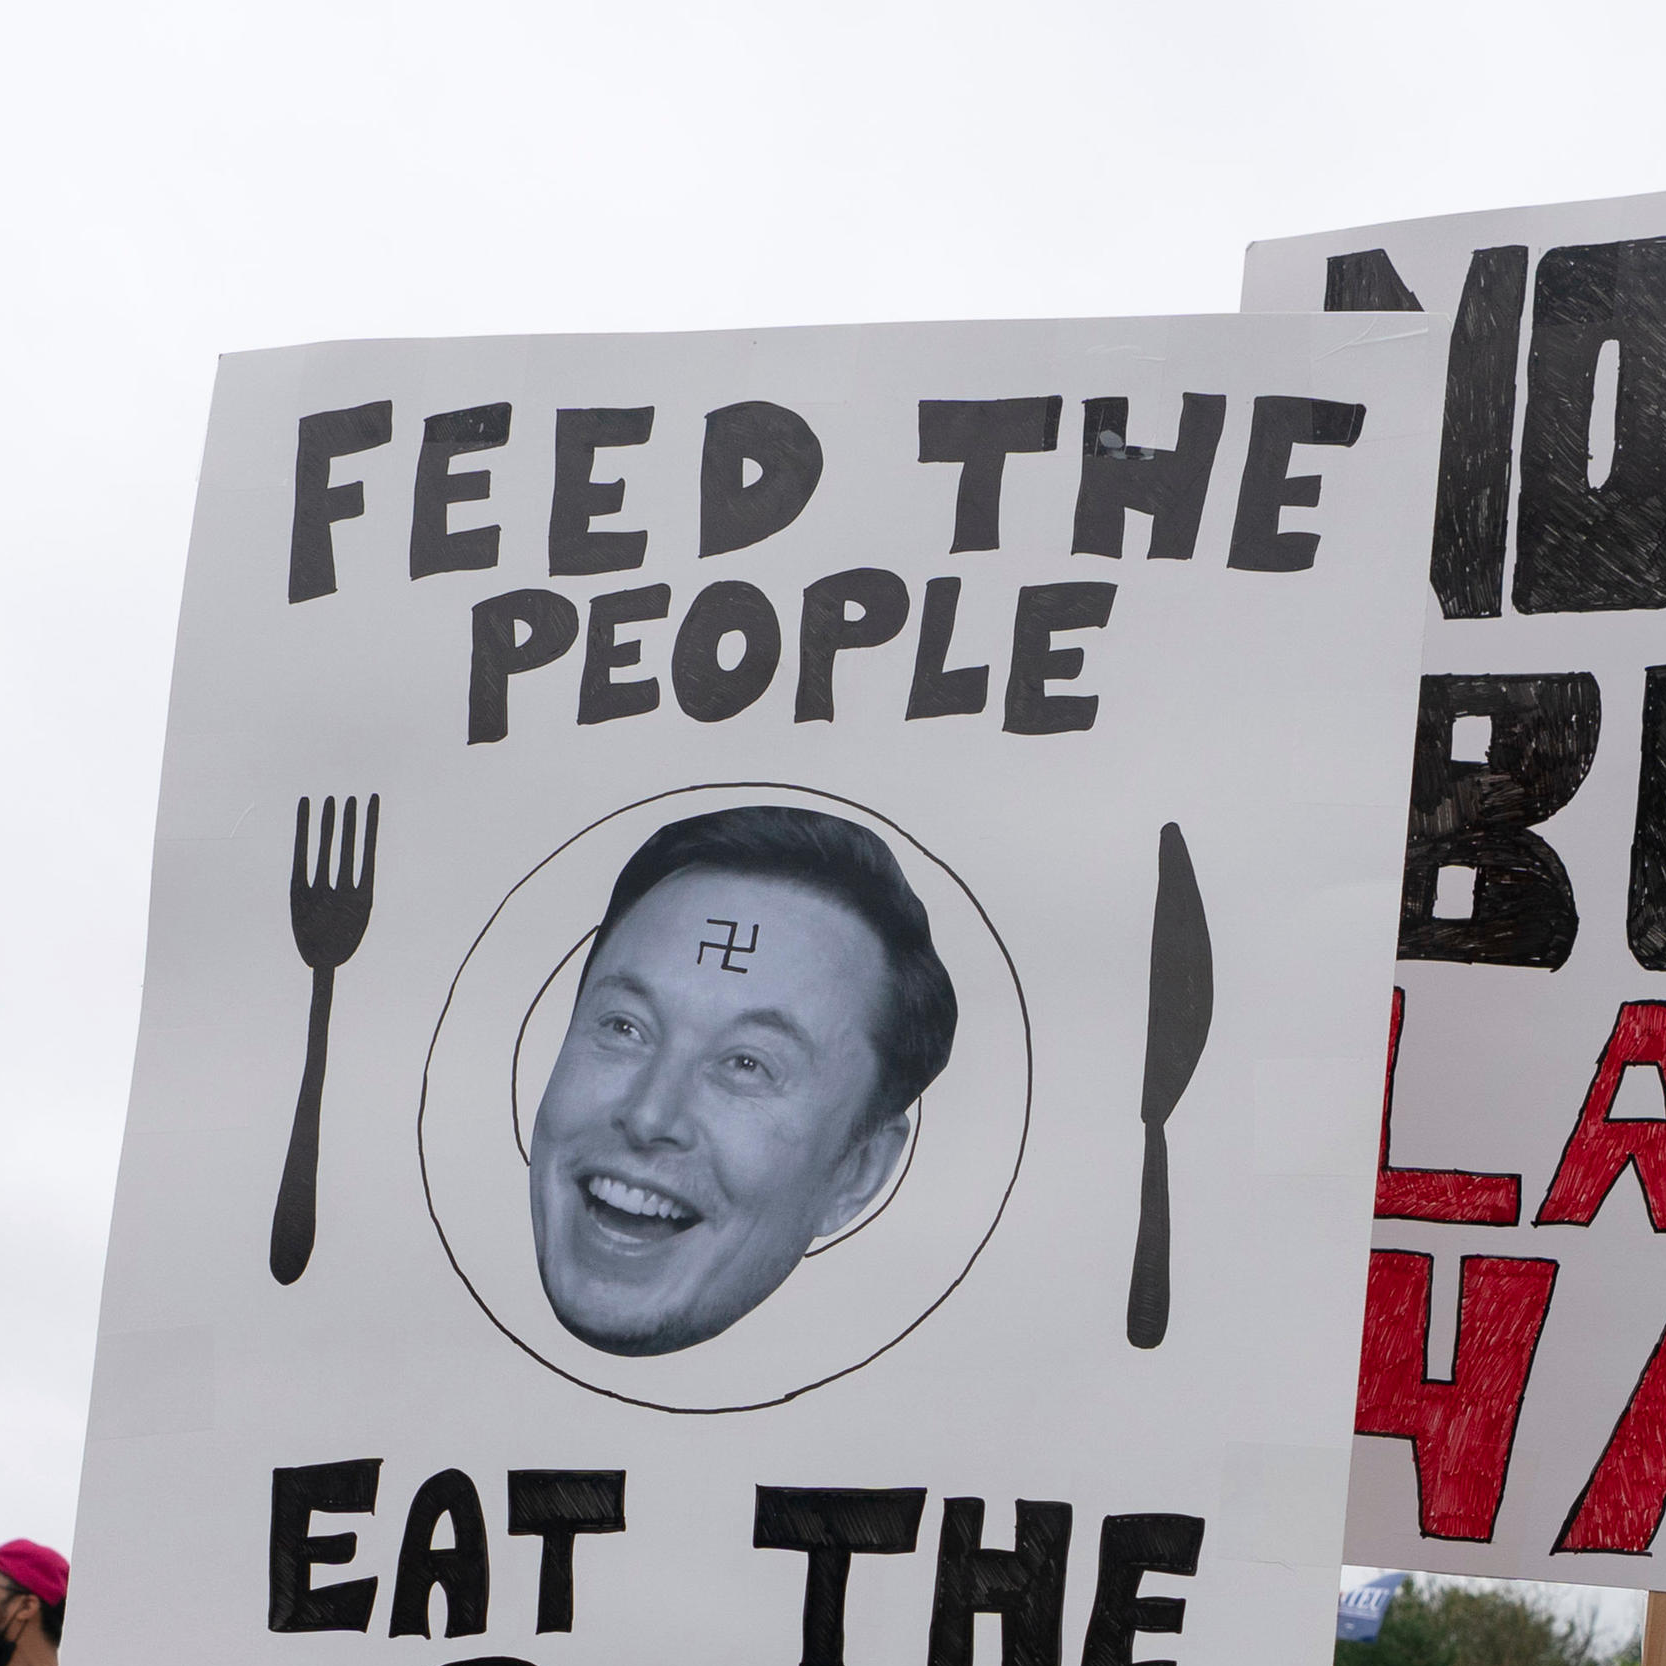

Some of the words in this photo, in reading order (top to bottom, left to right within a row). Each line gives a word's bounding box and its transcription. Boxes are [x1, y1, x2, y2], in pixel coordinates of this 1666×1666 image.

[288, 400, 825, 603] FEED
[919, 394, 1367, 572] THE
[467, 567, 1118, 745] PEOPLE
[268, 1458, 627, 1640] EAT
